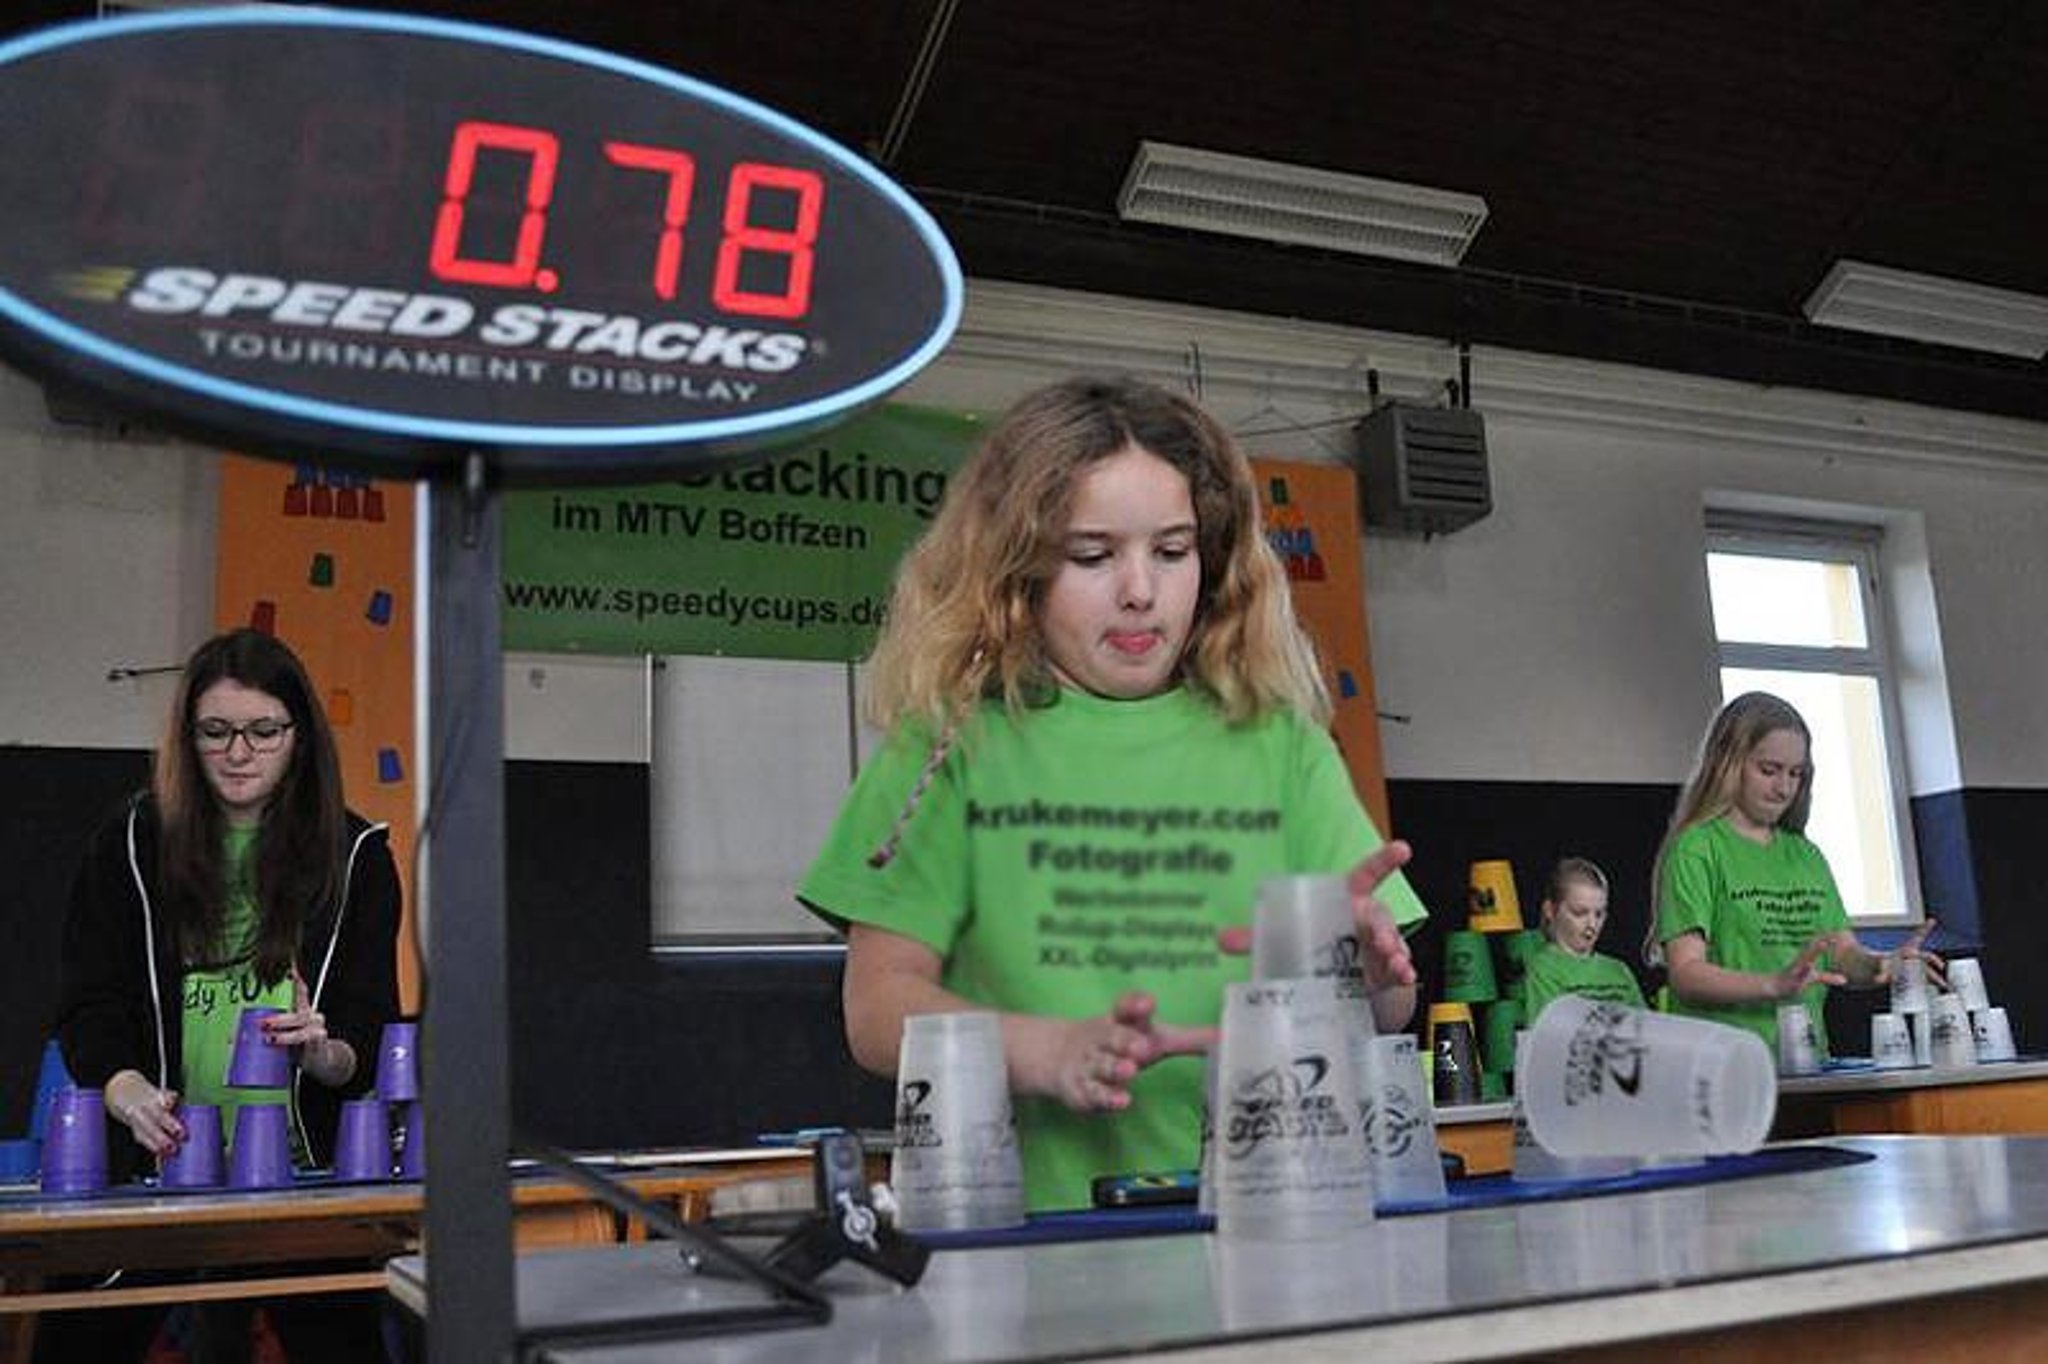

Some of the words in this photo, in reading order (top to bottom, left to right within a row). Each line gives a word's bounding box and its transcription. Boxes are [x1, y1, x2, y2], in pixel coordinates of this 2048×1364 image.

[430, 120, 824, 320] 0.78
[129, 266, 475, 337] SPEED
[480, 304, 807, 372] STACKS
[200, 329, 548, 383] TOURNAMENT
[569, 364, 759, 402] DISPLAY
[680, 450, 947, 520] tacking
[552, 496, 601, 531] im
[616, 501, 707, 538] MTV
[718, 508, 867, 549] Boffzen
[1028, 842, 1234, 877] Fotografie
